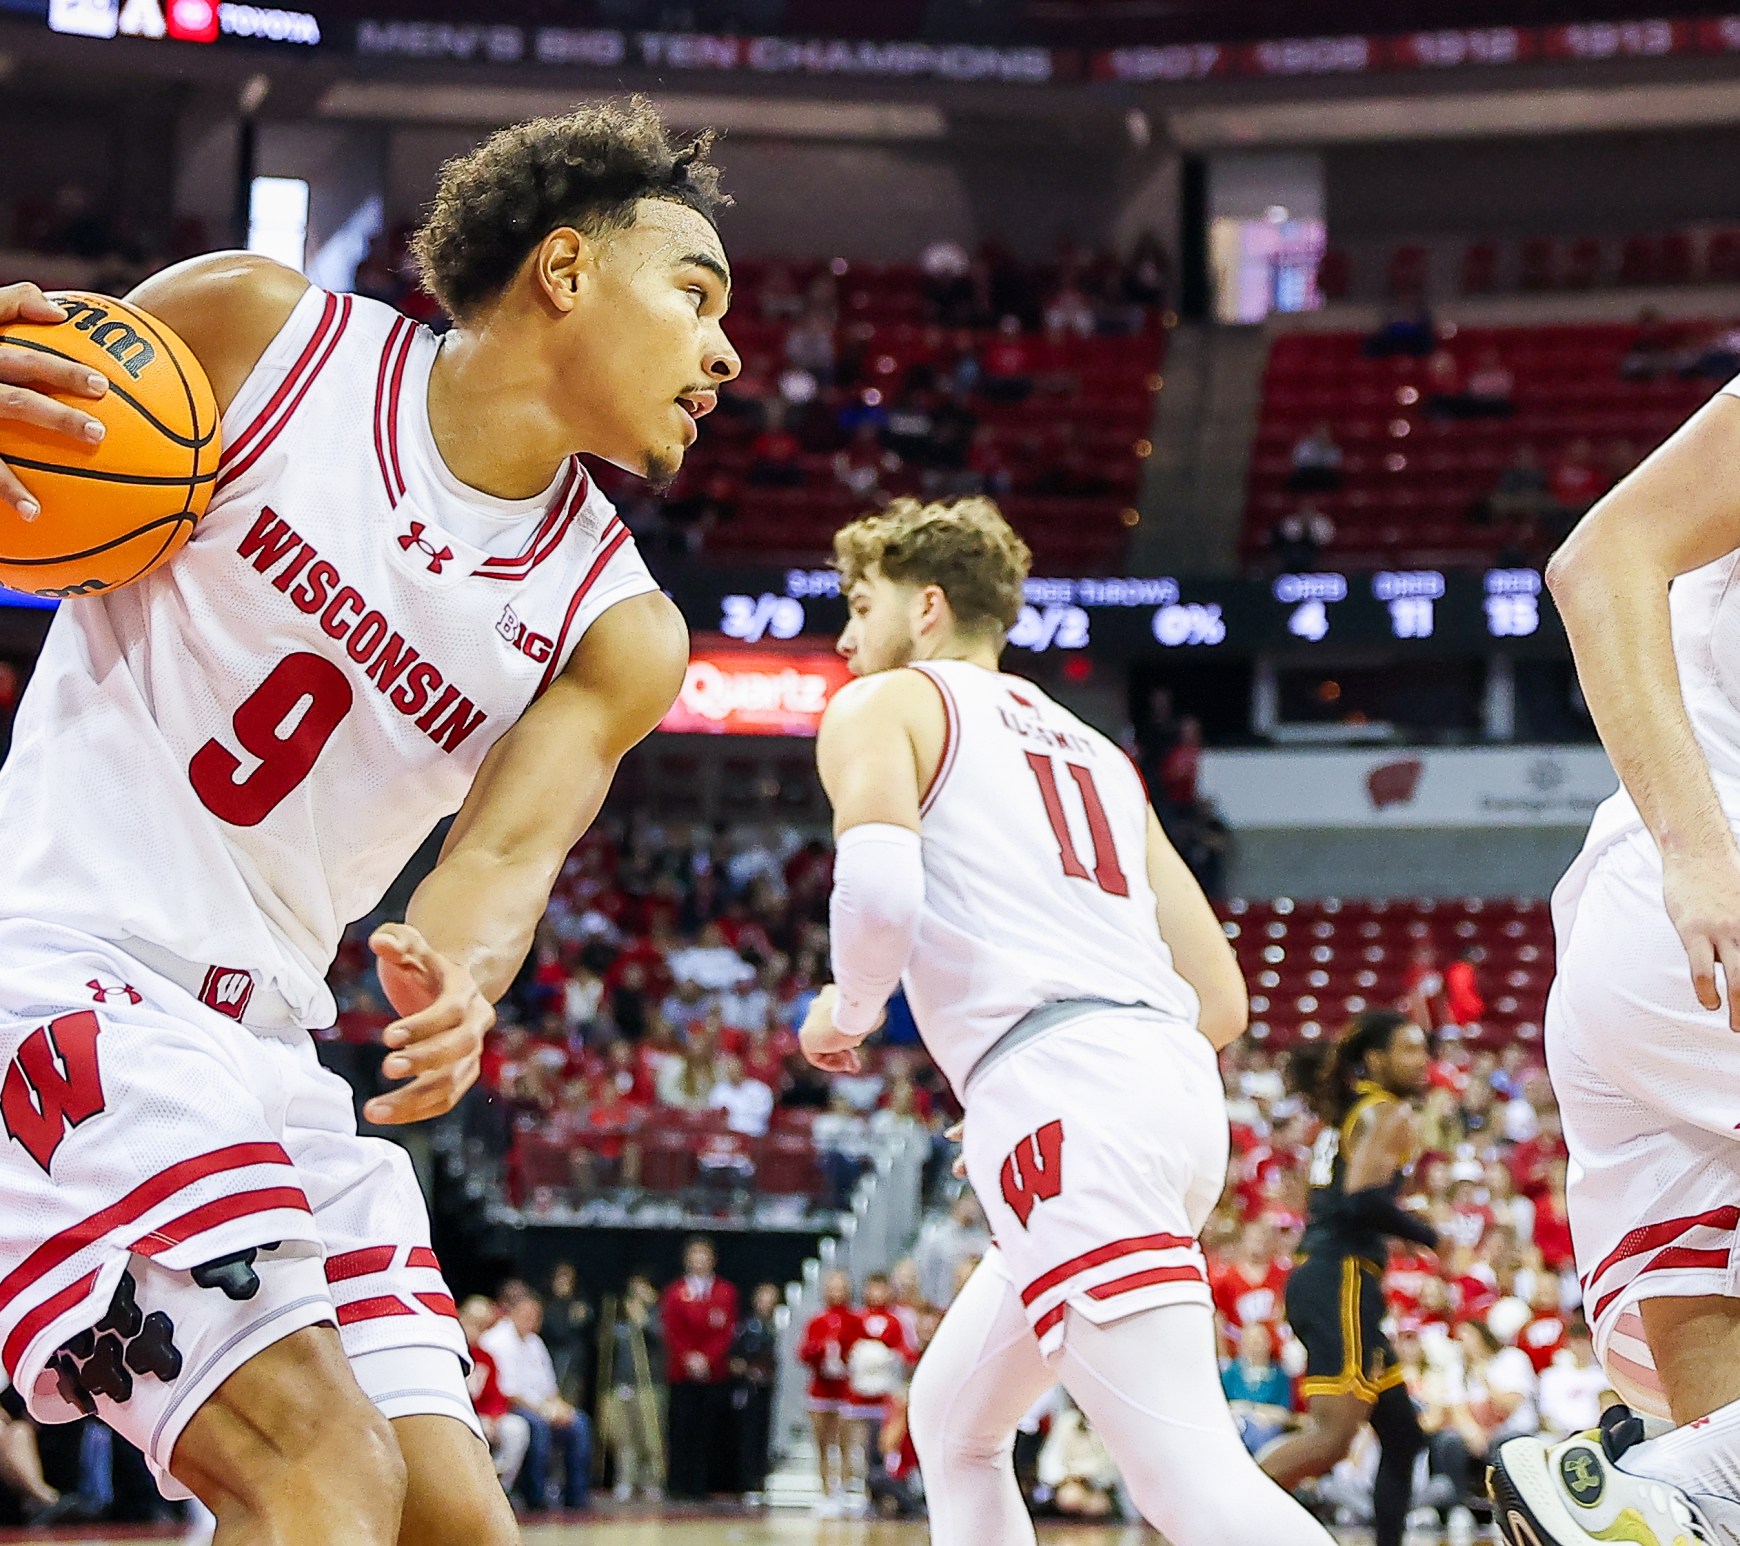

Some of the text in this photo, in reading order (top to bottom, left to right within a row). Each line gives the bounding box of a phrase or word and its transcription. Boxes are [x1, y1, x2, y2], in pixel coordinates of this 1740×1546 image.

[219, 2, 320, 45] TOYOTA
[536, 27, 625, 64] BIG
[636, 33, 738, 69] TEN
[748, 37, 1052, 81] CHAMPIONS
[237, 505, 487, 754] WISCONSIN
[721, 593, 804, 642] 3/9
[1153, 603, 1226, 646] 0%
[1289, 601, 1329, 641] 4
[1389, 599, 1434, 638] 11
[682, 661, 827, 720] Quartz
[188, 651, 353, 826] 9
[1024, 749, 1129, 898] 11
[0, 1009, 105, 1177] W
[1001, 1119, 1065, 1232] W
